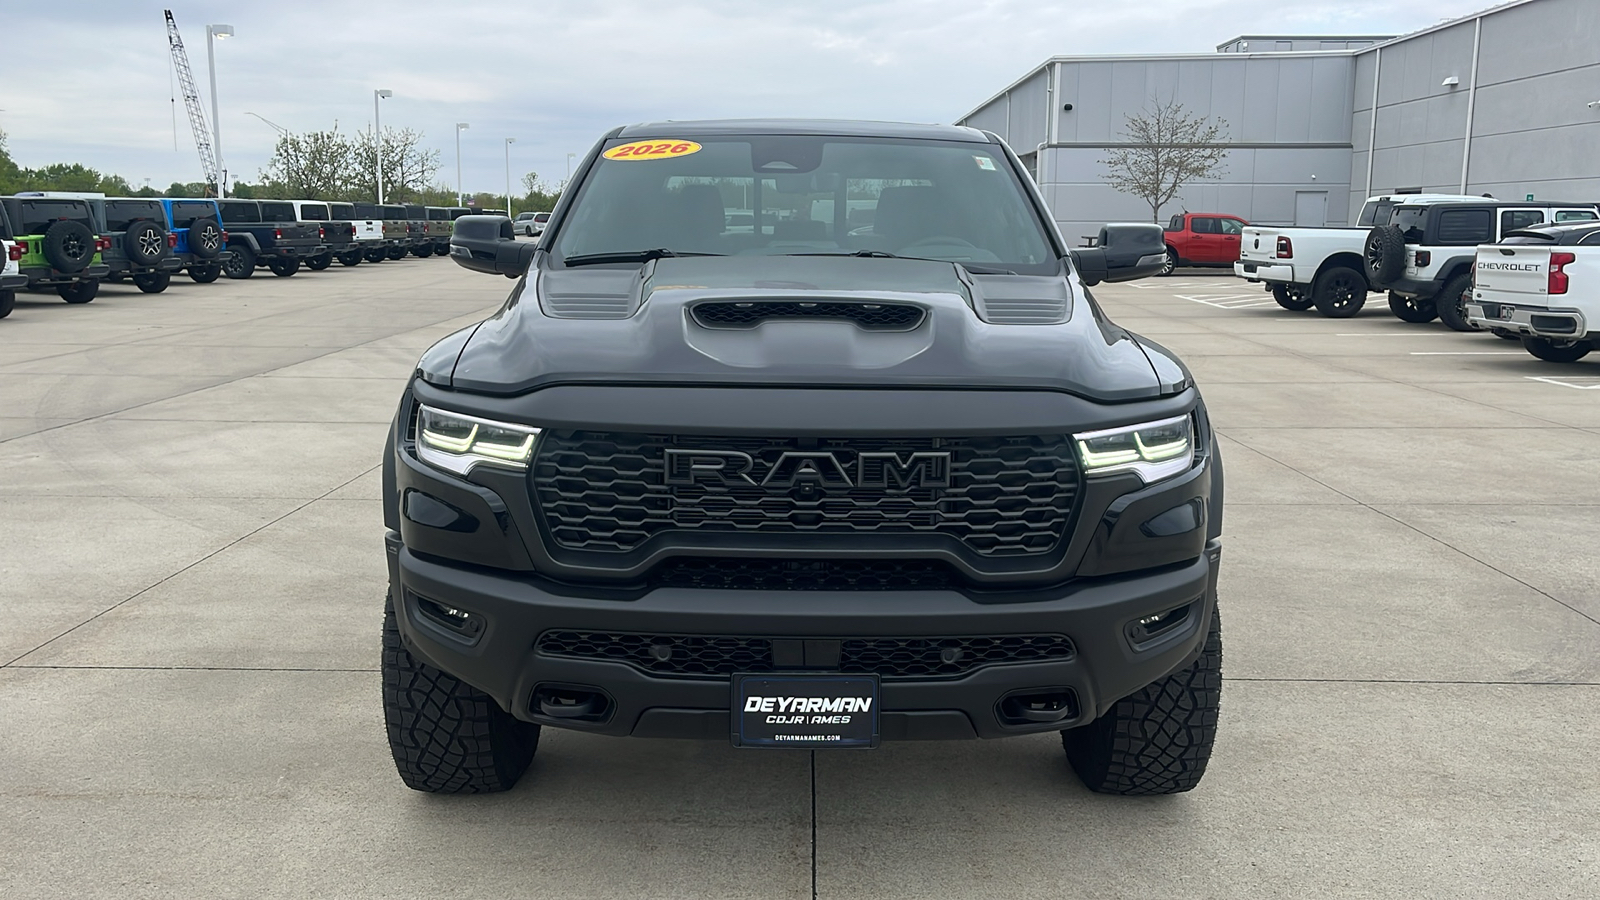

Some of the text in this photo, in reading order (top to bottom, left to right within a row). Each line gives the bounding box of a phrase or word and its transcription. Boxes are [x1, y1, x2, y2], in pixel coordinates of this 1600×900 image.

[612, 143, 691, 158] 2026
[1477, 262, 1541, 272] CHEVROLET
[664, 448, 951, 488] RAM
[743, 696, 873, 713] DEYARMAN
[810, 715, 851, 724] AMES
